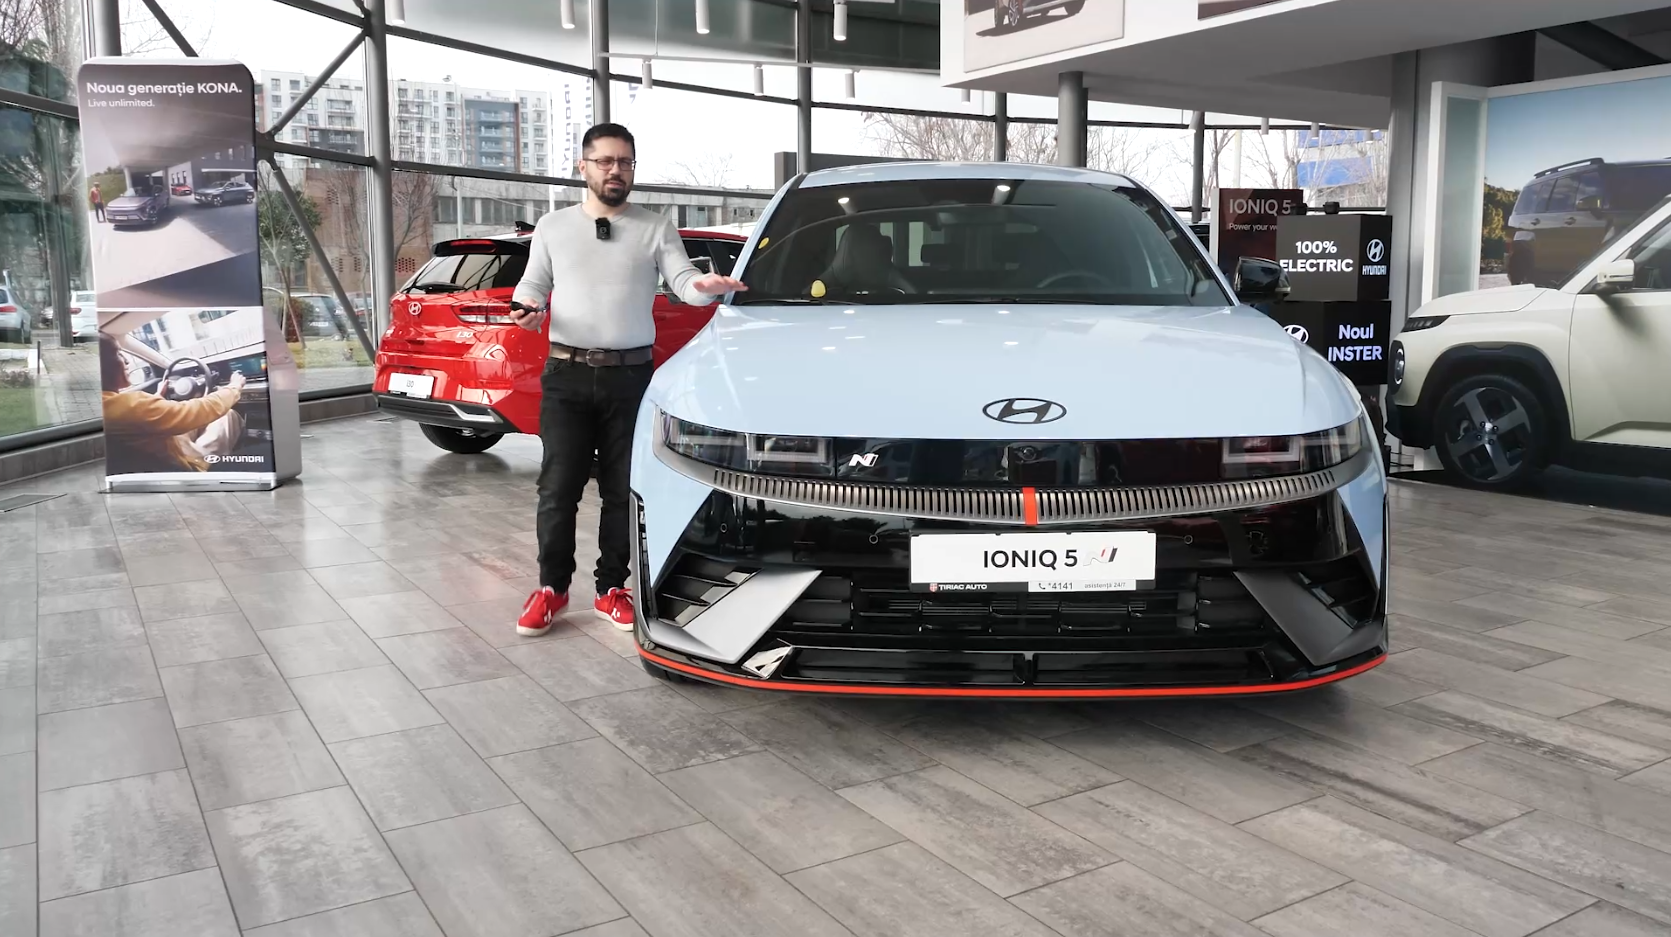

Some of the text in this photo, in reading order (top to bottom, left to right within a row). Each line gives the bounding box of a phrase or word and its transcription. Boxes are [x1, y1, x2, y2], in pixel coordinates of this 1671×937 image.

[87, 83, 125, 93] Noua
[198, 83, 242, 93] KONA.
[88, 99, 155, 108] Live unlimited.
[1229, 199, 1291, 216] IONIQ 5
[1229, 223, 1251, 231] Power
[1252, 224, 1269, 232] your
[1295, 241, 1337, 254] 100%
[1280, 259, 1354, 272] ELECTRIC
[1362, 265, 1387, 275] HYUNDAI
[1338, 324, 1374, 340] Noul
[1328, 346, 1383, 361] INSTER
[222, 455, 264, 463] HYUNDAI
[983, 550, 1057, 571] IONIQ
[1064, 549, 1078, 567] 5
